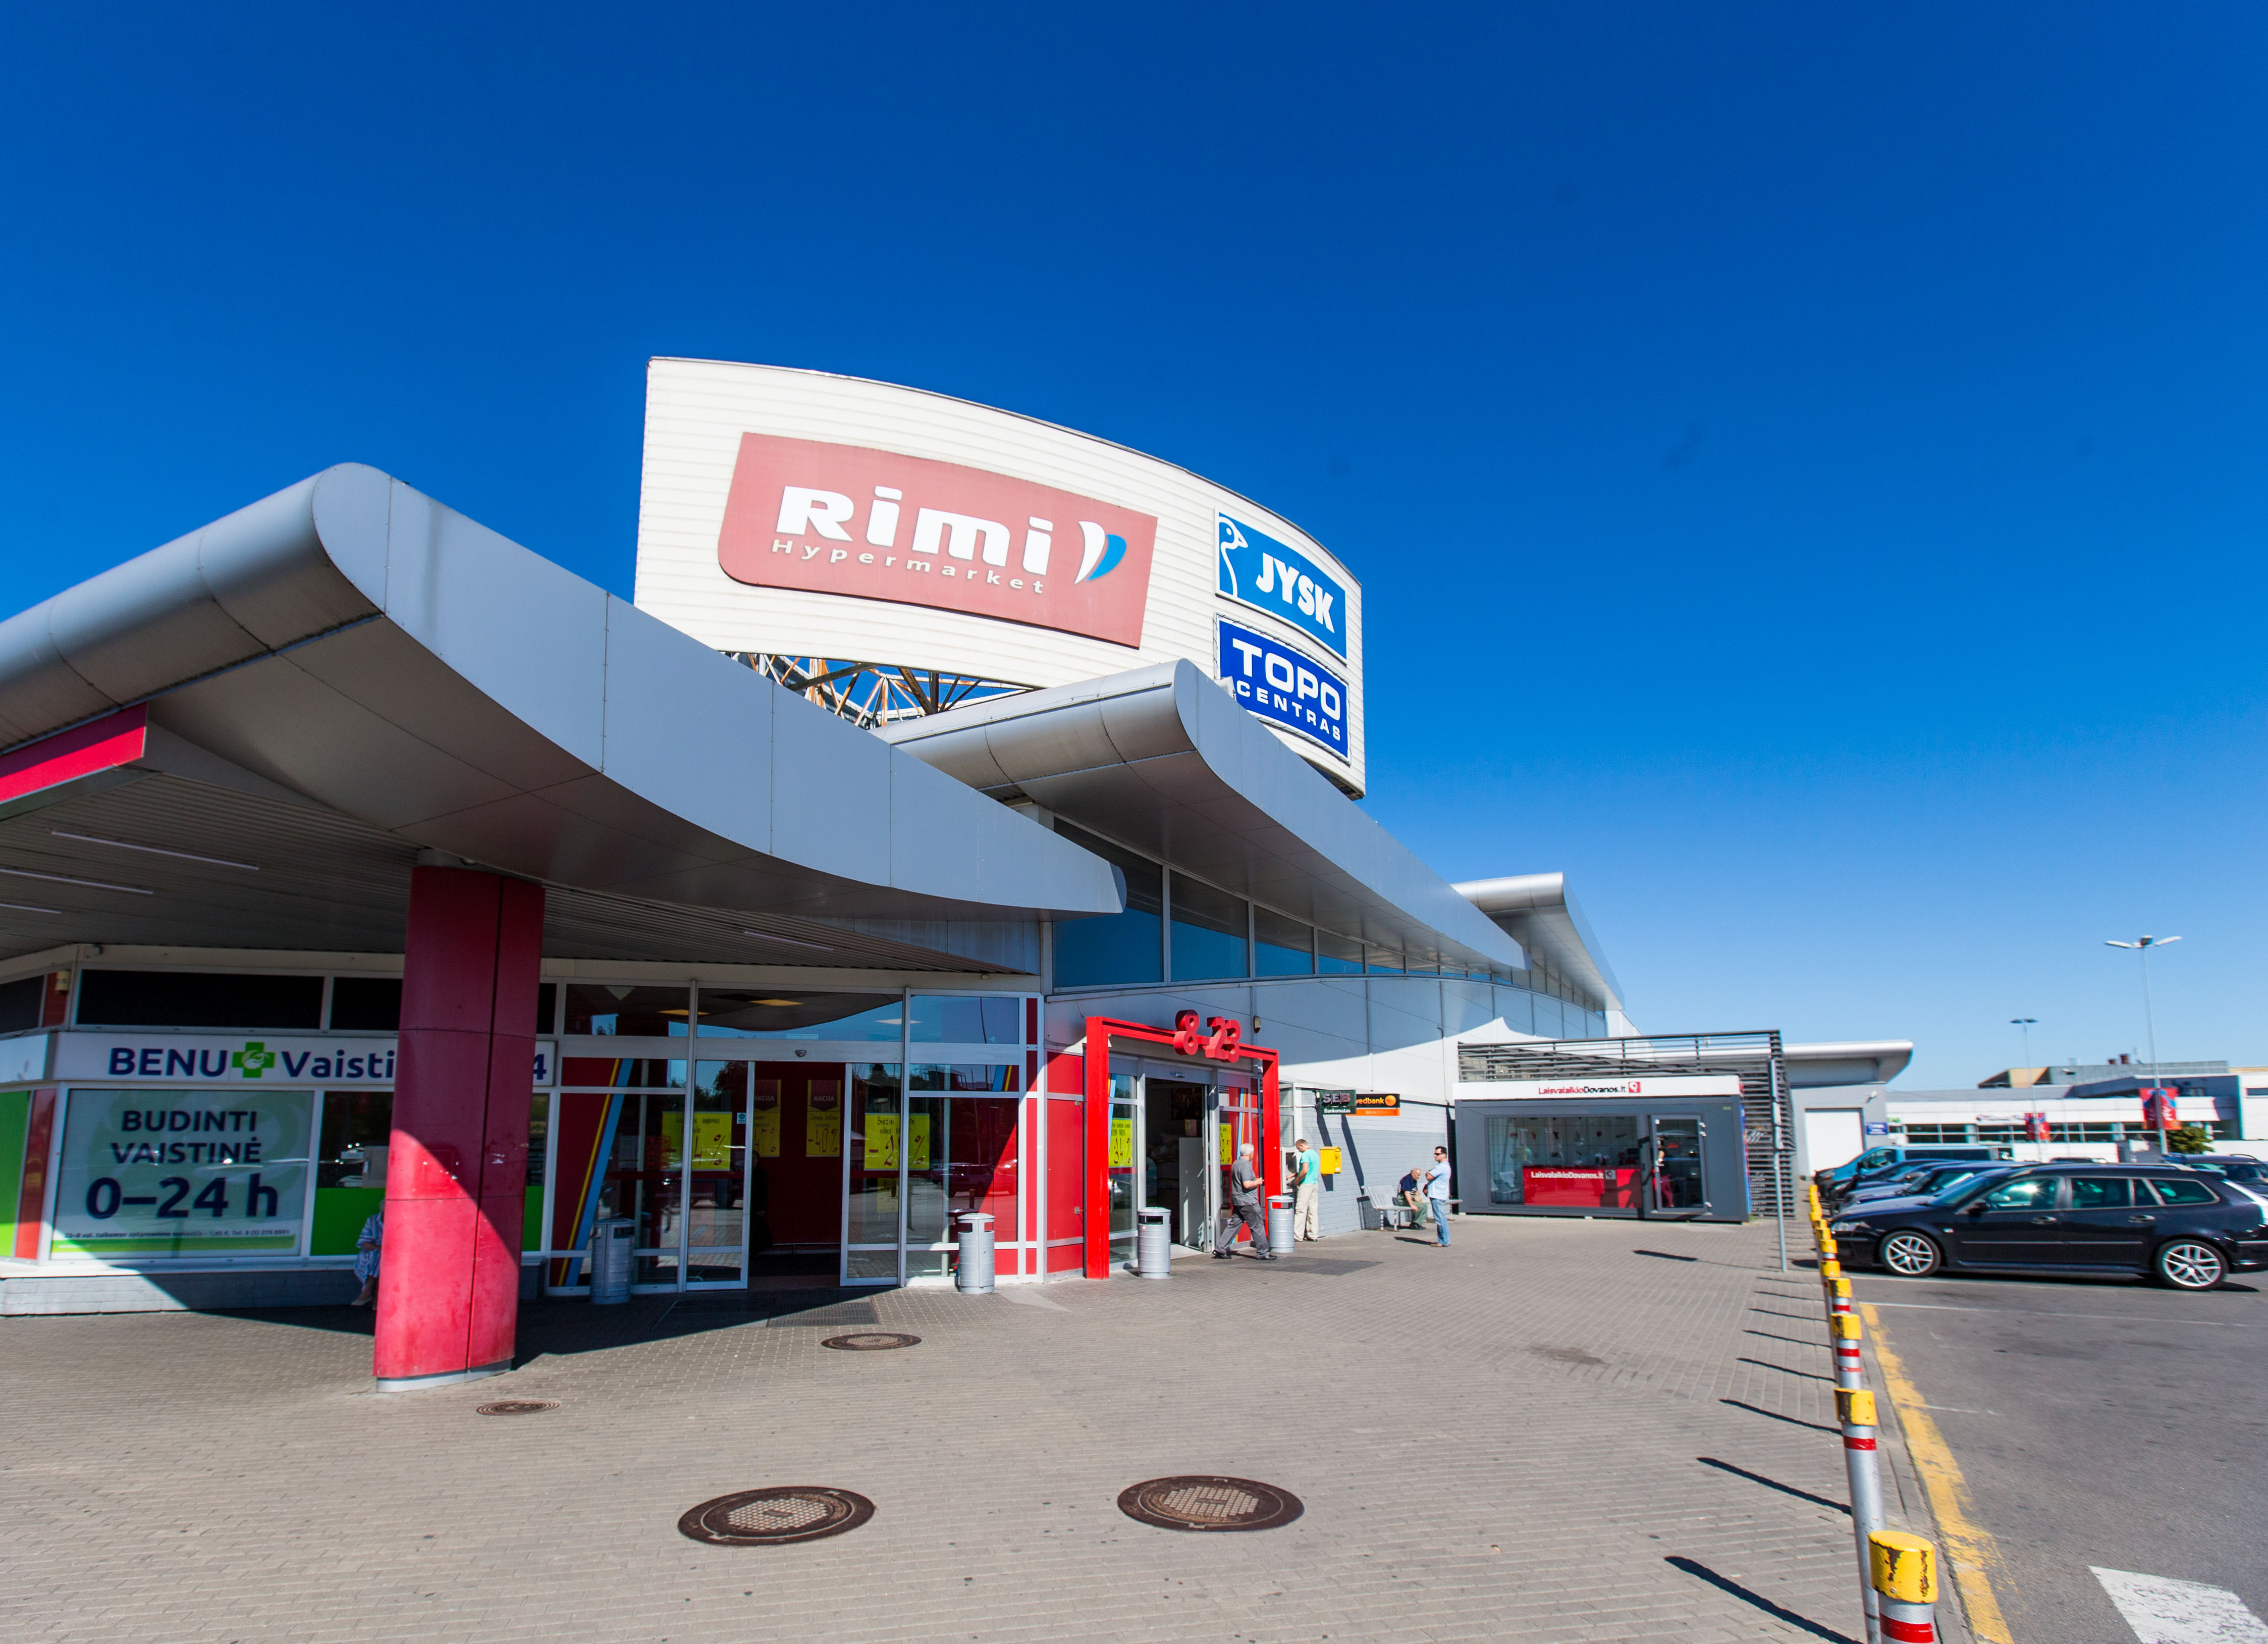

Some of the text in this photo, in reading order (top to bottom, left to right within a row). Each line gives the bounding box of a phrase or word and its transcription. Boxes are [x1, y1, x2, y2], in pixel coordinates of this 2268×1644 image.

[776, 485, 1053, 575] Rimi
[772, 539, 1044, 595] Hypermarket
[1256, 552, 1335, 633] JYSK
[1232, 638, 1340, 721] TOPO
[1236, 679, 1340, 741] CENTRAS
[108, 1047, 228, 1077] BENU
[281, 1050, 395, 1078] Vaisti
[1322, 1093, 1351, 1104] SEB
[1539, 1086, 1627, 1094] LaisvalaikioDovanos.lt
[122, 1110, 257, 1132] BUDINTI
[111, 1137, 261, 1163] VAISTINĖ
[1531, 1171, 1604, 1179] LaisvalaikioDovanos.lt
[246, 1173, 278, 1217] h
